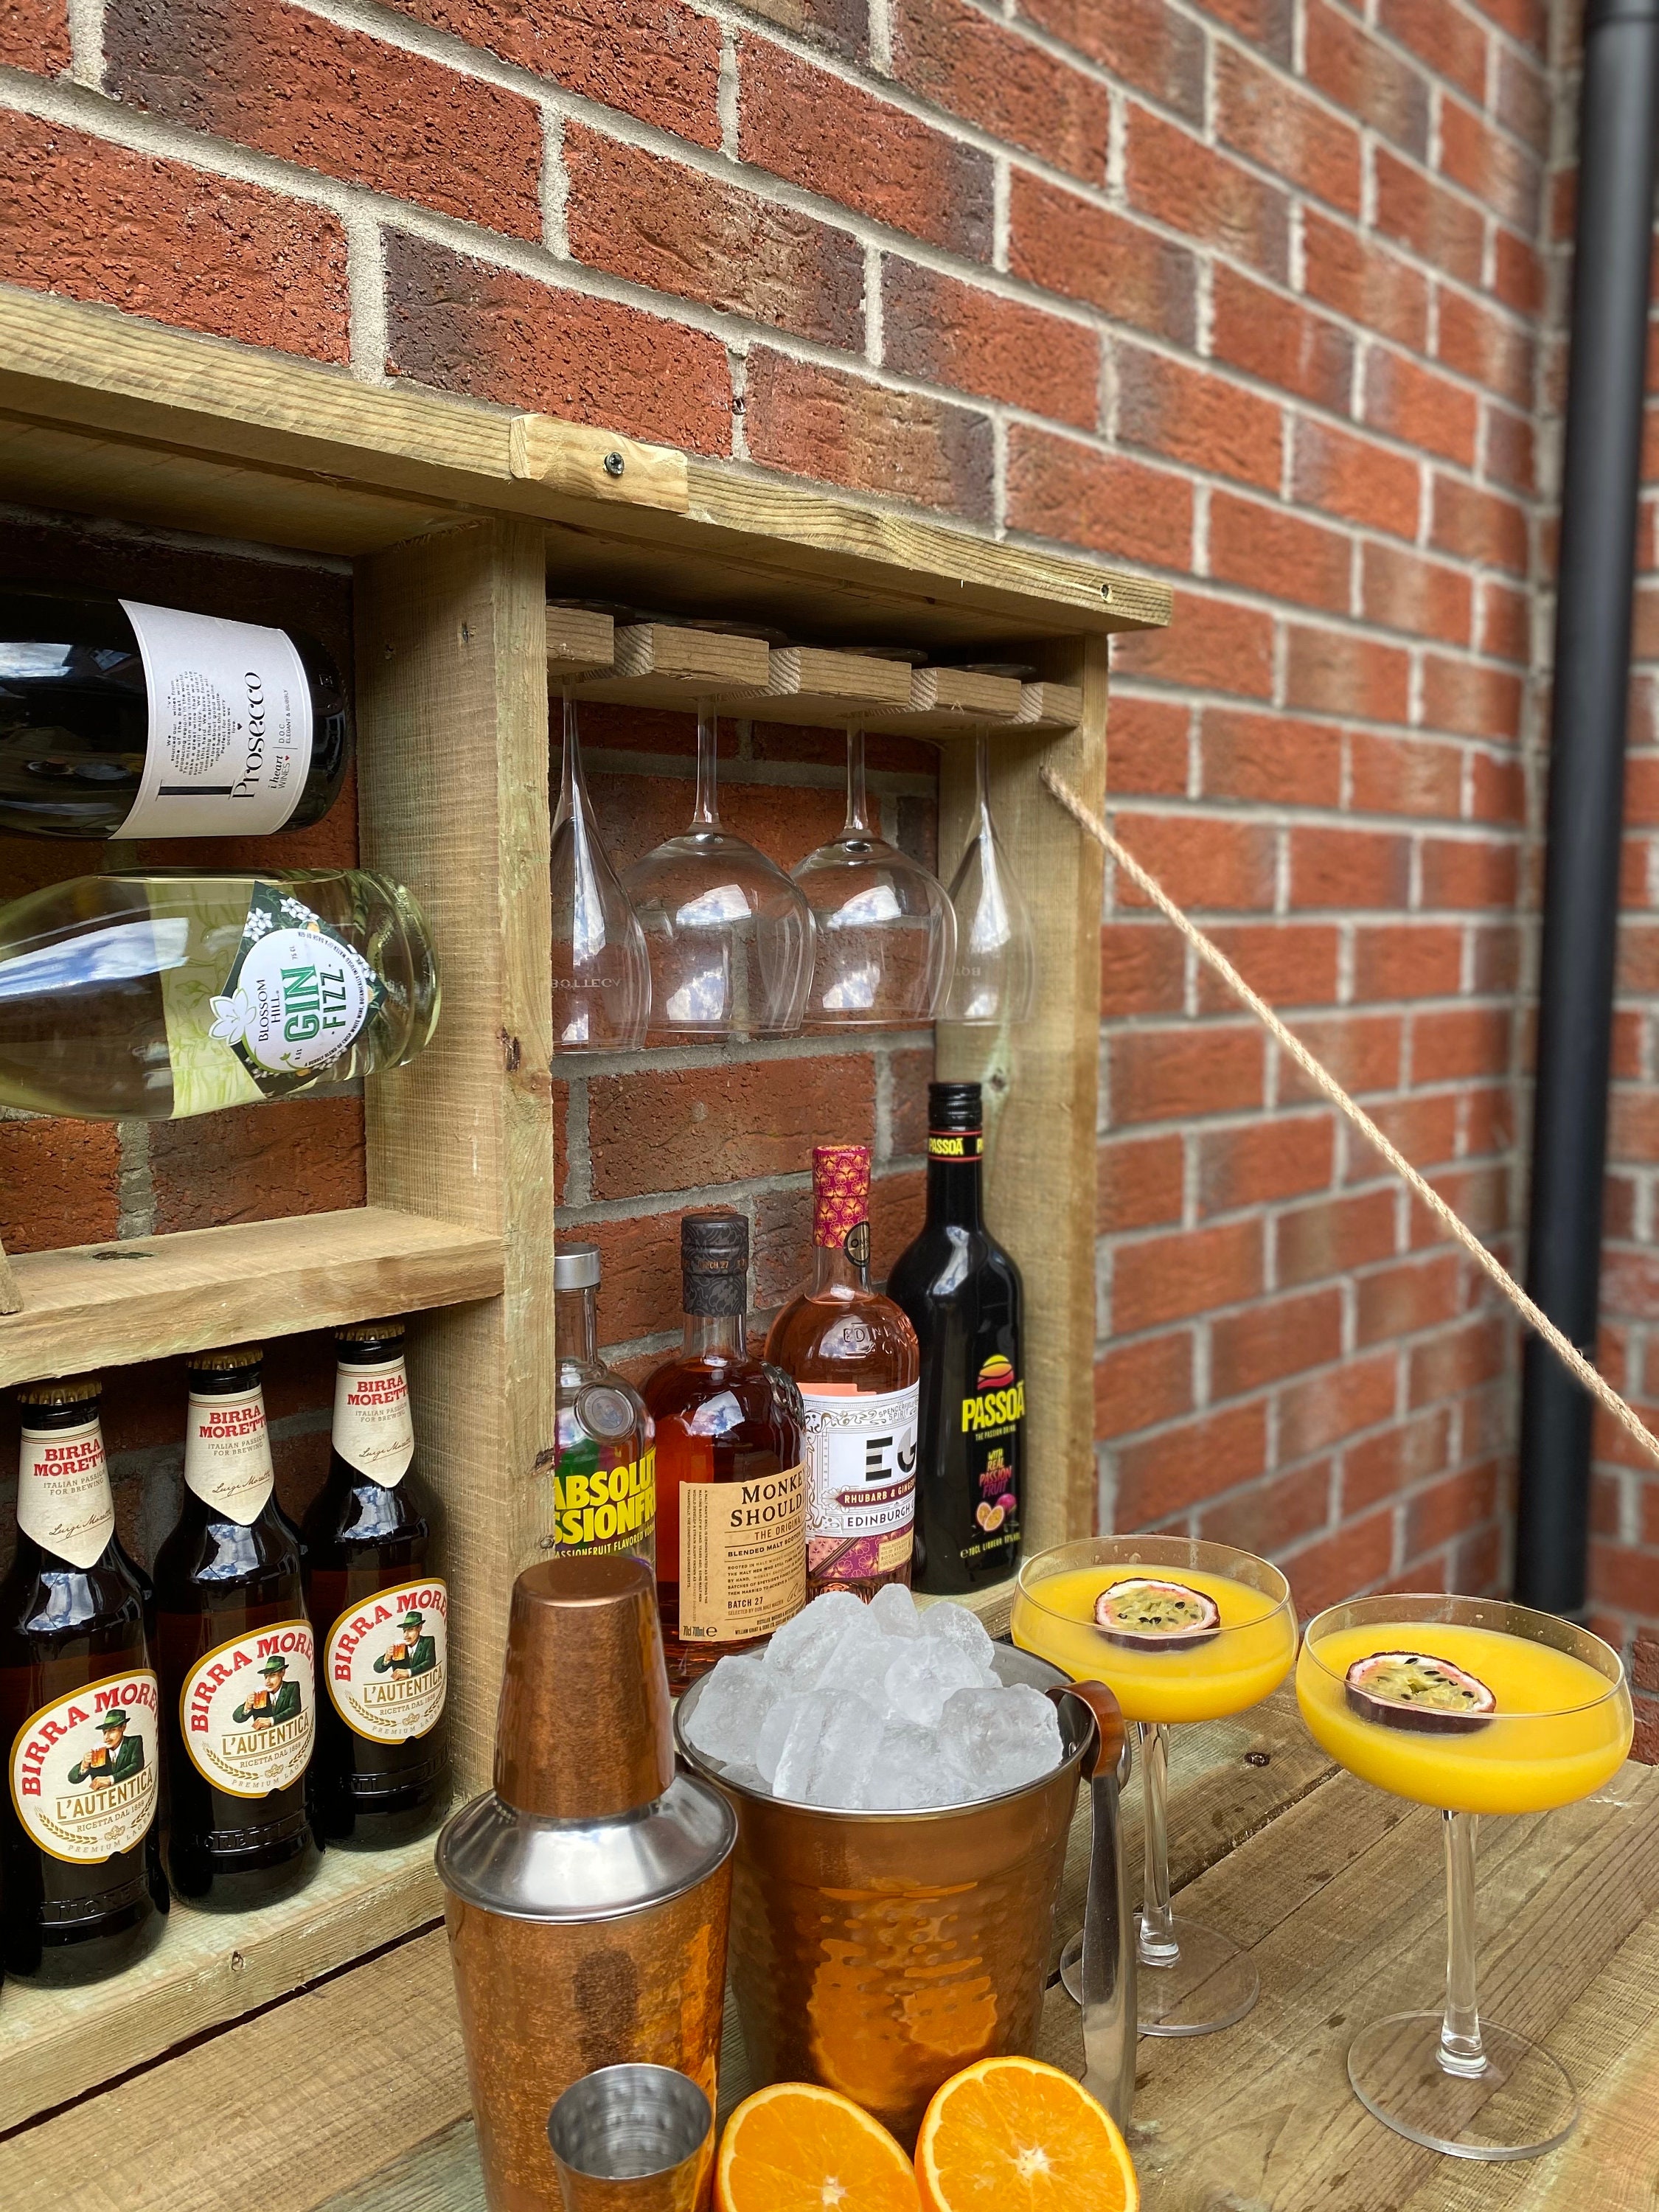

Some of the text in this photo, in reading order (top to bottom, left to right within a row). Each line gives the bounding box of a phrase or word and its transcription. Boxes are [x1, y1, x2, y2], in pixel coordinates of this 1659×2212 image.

[232, 672, 265, 798] Prosecco
[269, 755, 282, 782] heart
[278, 763, 290, 789] WINES
[344, 958, 358, 975] INFUSED
[320, 969, 347, 1029] FIZZ
[355, 975, 364, 1004] BOTANICALLY
[257, 979, 268, 1042] BLOSSOM
[271, 997, 280, 1023] HILL
[280, 964, 320, 1042] GIN
[351, 1020, 361, 1032] WHITE
[341, 1033, 352, 1044] CRISP
[357, 1375, 403, 1392] BIRRA
[209, 1405, 260, 1425] BIRRA
[378, 1410, 406, 1422] BREWING
[889, 1408, 908, 1420] SPIRIT
[242, 1433, 265, 1447] PASSION
[975, 1432, 984, 1441] THE
[984, 1427, 1002, 1439] PASSION
[45, 1439, 100, 1461] BIRRA
[232, 1442, 263, 1455] BREWING
[988, 1448, 1003, 1460] WITH
[987, 1457, 1005, 1472] REAL
[44, 1470, 106, 1489] ITALIAN PASSION
[72, 1478, 104, 1493] BREWING
[979, 1466, 1012, 1486] PASSION
[844, 1479, 915, 1503] RHUBARB & GINGER
[982, 1479, 1009, 1498] FRUIT
[848, 1506, 910, 1526] EDINBURGH
[614, 1532, 643, 1551] FLAVORED
[728, 1548, 764, 1557] BLENDED
[767, 1542, 783, 1551] MALT
[785, 1531, 801, 1545] SCOTCH
[755, 1529, 771, 1540] THE
[983, 1537, 1002, 1551] LIQUEUR
[728, 1597, 763, 1608] BATCH 27
[335, 1605, 392, 1681] BIRRA
[191, 1651, 252, 1733] BIRRA
[364, 1667, 442, 1704] L'AUTENTICA
[380, 1705, 410, 1716] RICETTA
[411, 1700, 425, 1709] DAL
[223, 1711, 309, 1756] L'AUTENTICA
[372, 1726, 415, 1734] PREMIUM
[22, 1706, 89, 1796] BIRRA
[240, 1755, 273, 1768] RICETTA
[274, 1750, 288, 1759] DAL
[232, 1778, 279, 1788] PREMIUM
[57, 1767, 153, 1820] L'AUTENTICA
[77, 1817, 114, 1832] RICETTA
[115, 1810, 130, 1821] DAL
[68, 1840, 120, 1853] PREMIUM
